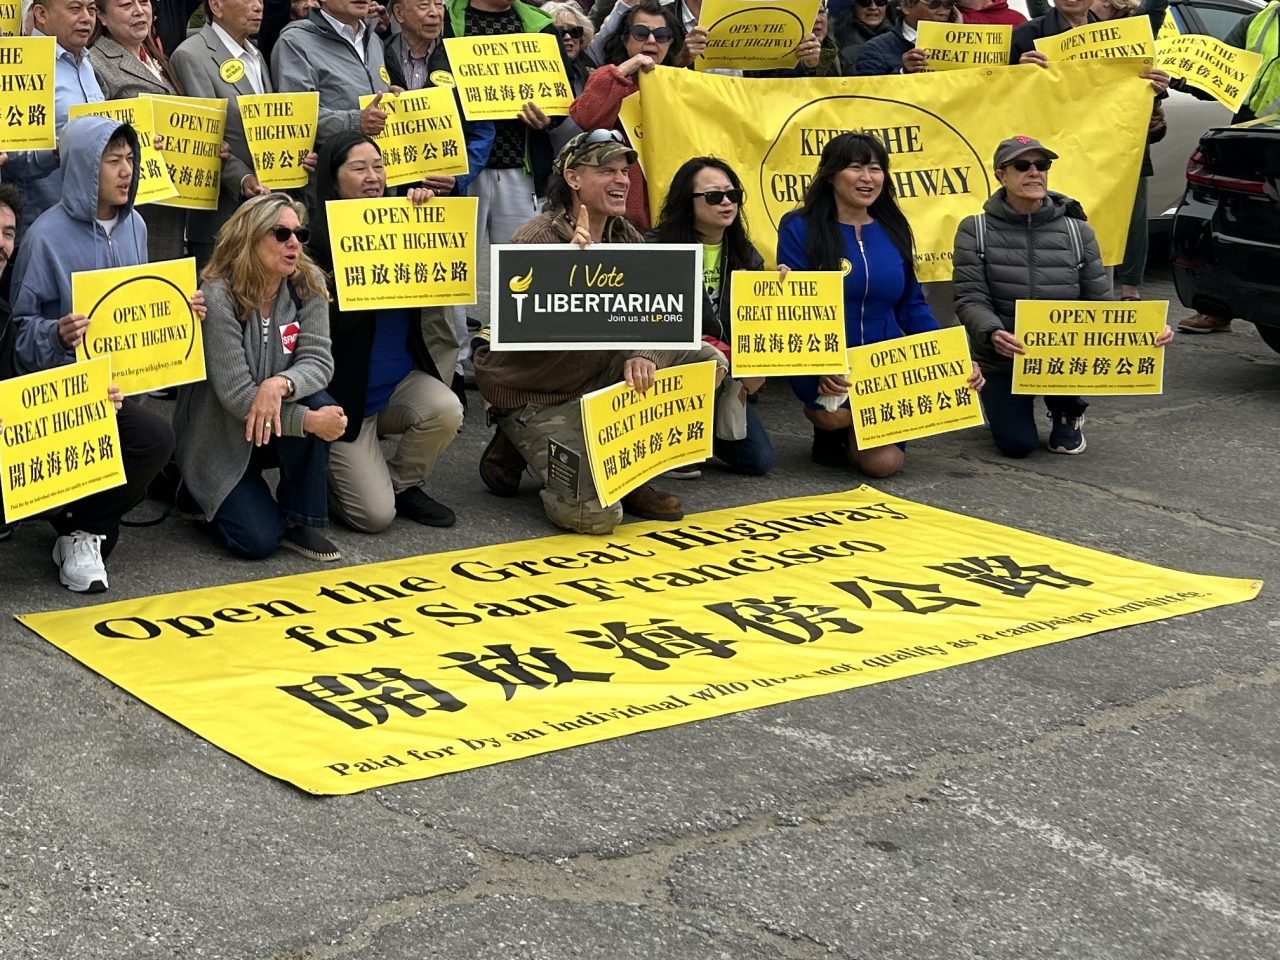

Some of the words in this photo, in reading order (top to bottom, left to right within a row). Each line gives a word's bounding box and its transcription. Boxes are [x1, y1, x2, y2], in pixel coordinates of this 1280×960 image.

[728, 23, 761, 34] OPEN
[763, 23, 787, 33] THE
[945, 30, 983, 44] OPEN
[986, 32, 1003, 45] THE
[472, 42, 509, 57] OPEN
[511, 40, 541, 54] THE
[705, 39, 744, 48] GREAT
[743, 38, 797, 48] HIGHWAY
[1060, 33, 1087, 52] OPEN
[1089, 27, 1121, 42] THE
[1171, 37, 1212, 47] OPEN
[1212, 42, 1238, 63] THE
[923, 48, 970, 63] GREAT
[1194, 48, 1249, 84] HIGHWAY
[458, 62, 500, 77] GREAT
[504, 59, 560, 76] HIGHWAY
[400, 96, 431, 113] THE
[255, 123, 313, 140] HIGHWAY
[391, 114, 453, 137] HIGHWAY
[771, 173, 813, 203] GRE
[892, 166, 972, 199] HWAY
[363, 206, 410, 225] OPEN
[413, 206, 446, 223] THE
[340, 233, 398, 253] GREAT
[403, 232, 469, 250] HIGHWAY
[344, 260, 468, 287] 開放海傍公路
[569, 264, 578, 288] I
[585, 263, 625, 288] Vote
[753, 281, 784, 297] OPEN
[787, 280, 818, 296] THE
[534, 293, 684, 313] LIBERTARIAN
[736, 305, 773, 322] GREAT
[776, 304, 838, 321] HIGHWAY
[113, 304, 147, 324] OPEN
[607, 314, 627, 323] Join
[640, 315, 650, 323] at
[651, 314, 683, 322] LP.ORG
[1049, 308, 1098, 324] OPEN
[1102, 309, 1137, 324] THE
[93, 332, 137, 354] GREAT
[141, 324, 188, 347] HIGHWAY
[1023, 331, 1079, 347] GREAT
[1084, 331, 1159, 347] HIGHWAY
[870, 346, 908, 369] OPEN
[909, 339, 941, 360] THE
[111, 359, 183, 380] penthegreathighway.com
[1022, 356, 1156, 376] 開放海傍公路
[854, 374, 898, 397] GREAT
[901, 358, 966, 386] HIGHWAY
[21, 381, 60, 410] OPEN
[61, 373, 89, 398] THE
[3, 416, 49, 448] GREAT
[52, 399, 109, 433] HIGHWAY
[598, 414, 637, 446] GREAT
[639, 393, 707, 427] HIGHWAY
[93, 598, 316, 642] Open
[315, 573, 447, 609] the
[450, 538, 656, 586] Great
[645, 500, 910, 552] Highway
[284, 616, 417, 653] for
[416, 586, 579, 629] San
[566, 537, 888, 607] Francisco
[276, 554, 1094, 730] 開放海傍公路
[324, 754, 407, 777] Paid
[406, 743, 461, 761] for
[455, 737, 502, 751] by
[505, 725, 550, 742] an
[543, 693, 693, 733] individual
[689, 676, 750, 701] who
[813, 661, 864, 677] not
[861, 643, 950, 670] qualify
[945, 637, 979, 649] as
[975, 632, 995, 641] a
